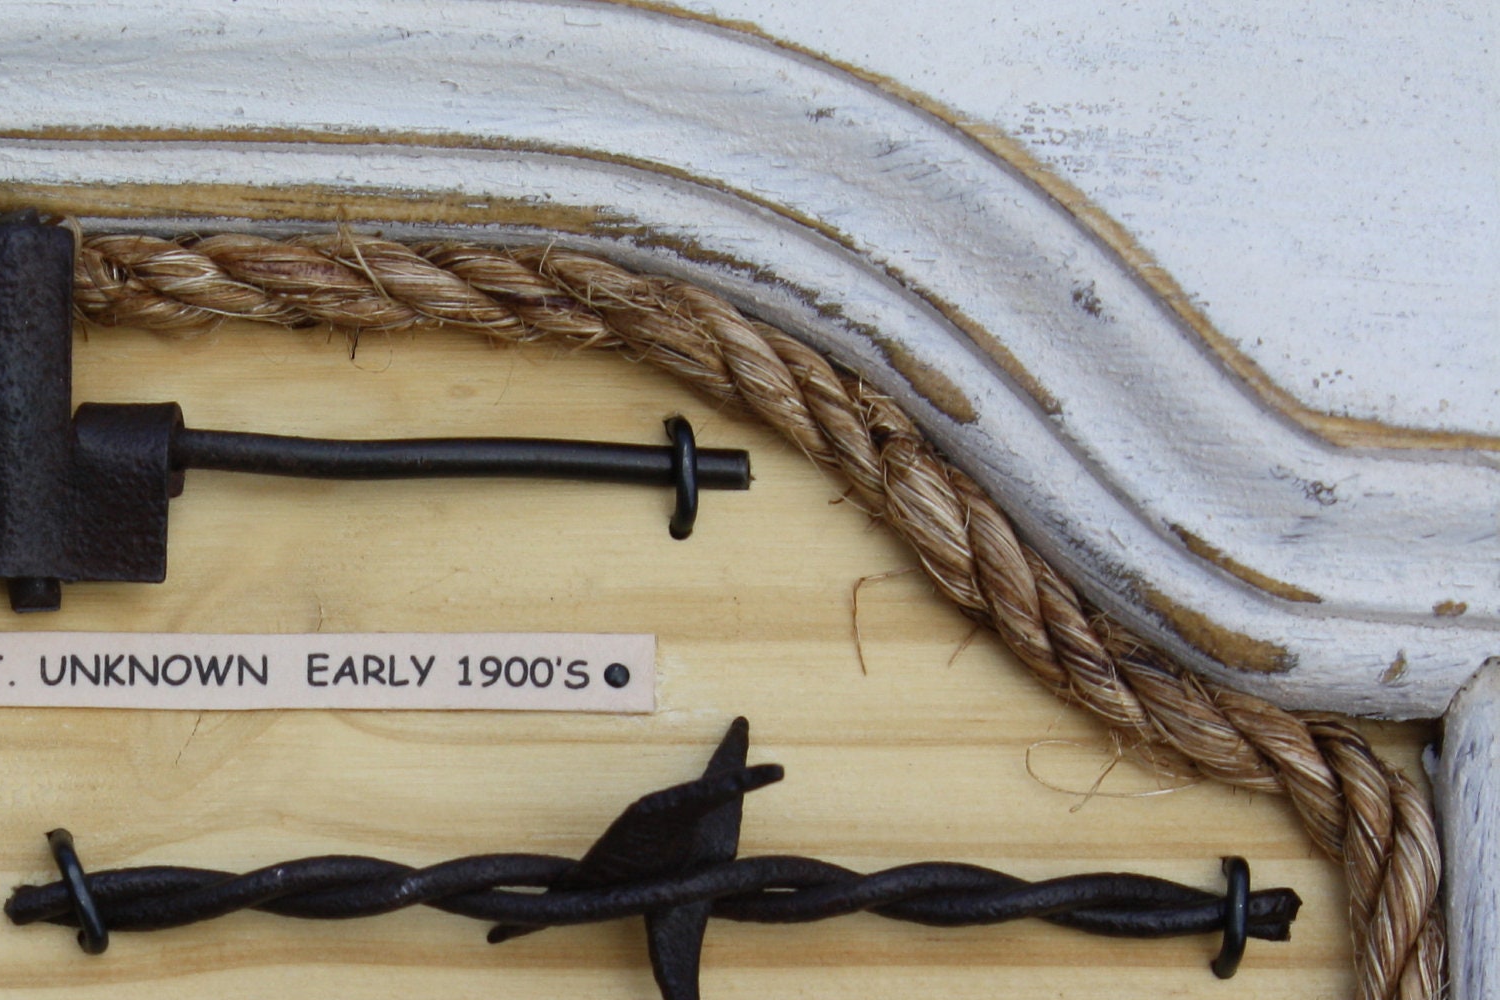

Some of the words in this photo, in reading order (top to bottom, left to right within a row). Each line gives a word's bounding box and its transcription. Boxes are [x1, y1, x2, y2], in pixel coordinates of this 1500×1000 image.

[40, 653, 268, 688] UNKNOWN
[307, 653, 436, 687] EARLY
[458, 655, 590, 690] 1900'S
